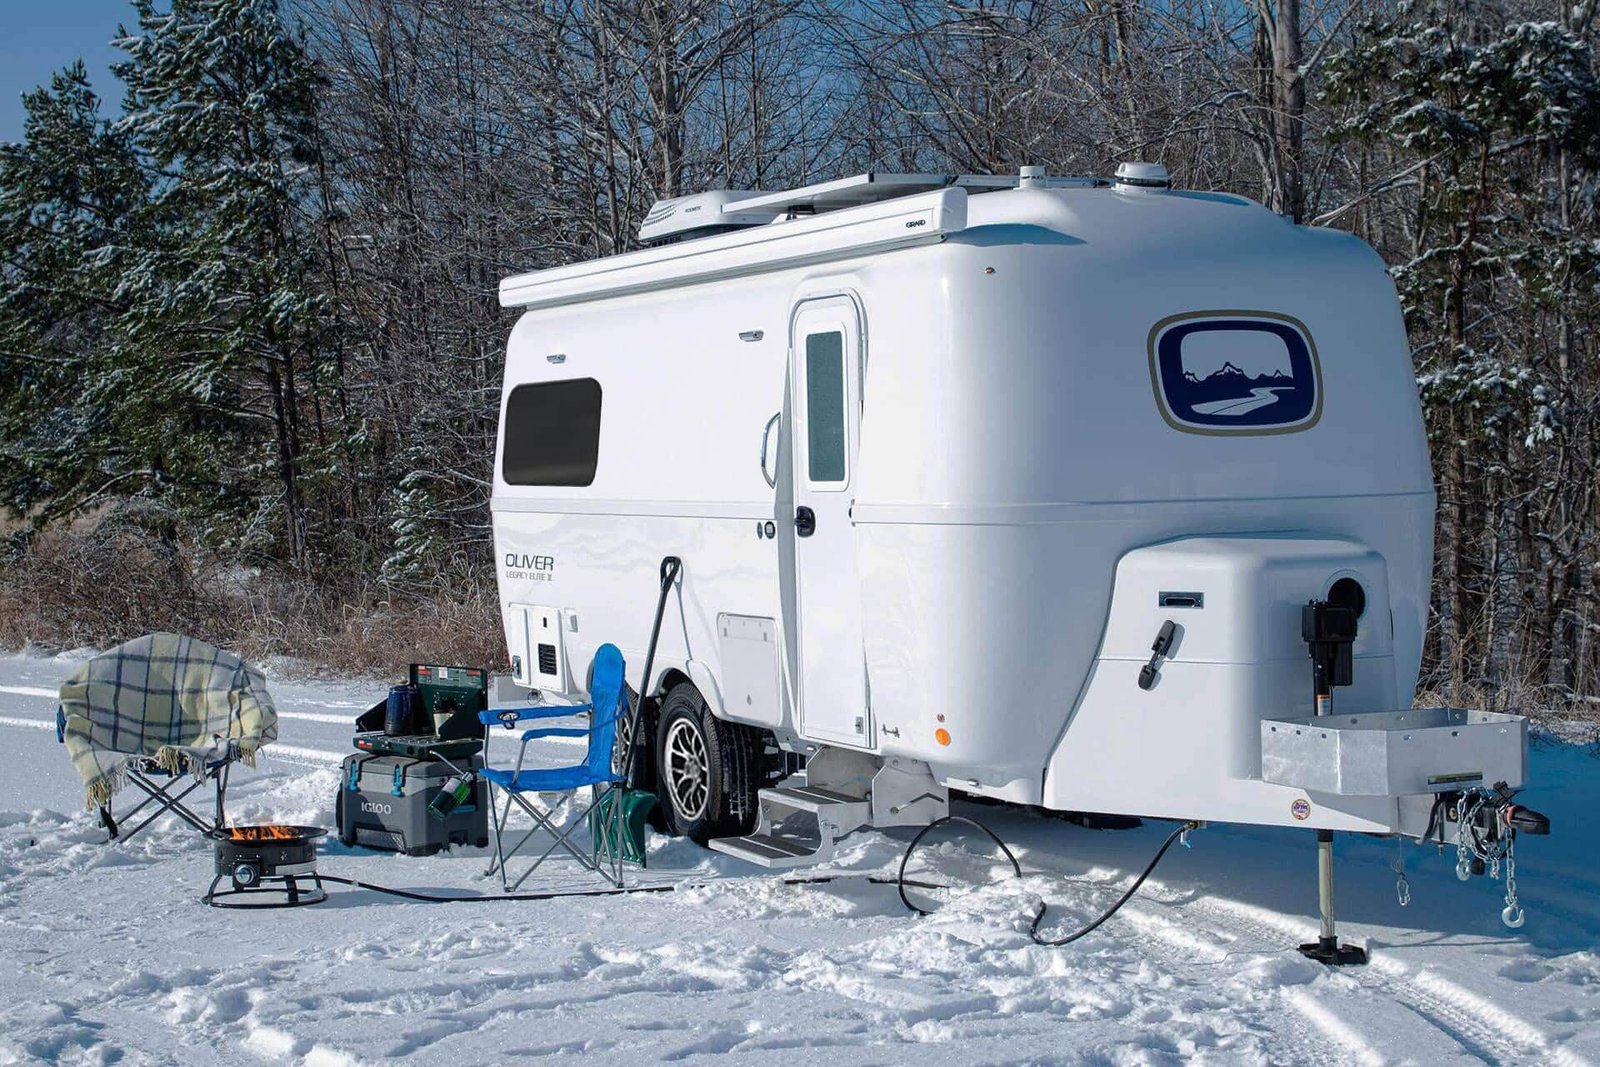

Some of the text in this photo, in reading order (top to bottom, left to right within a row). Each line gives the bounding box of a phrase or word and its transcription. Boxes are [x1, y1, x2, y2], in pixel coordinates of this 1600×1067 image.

[505, 553, 554, 571] OLIVER
[505, 570, 528, 580] LEGACY
[529, 572, 546, 581] ELITE
[361, 801, 392, 815] IGLOO
